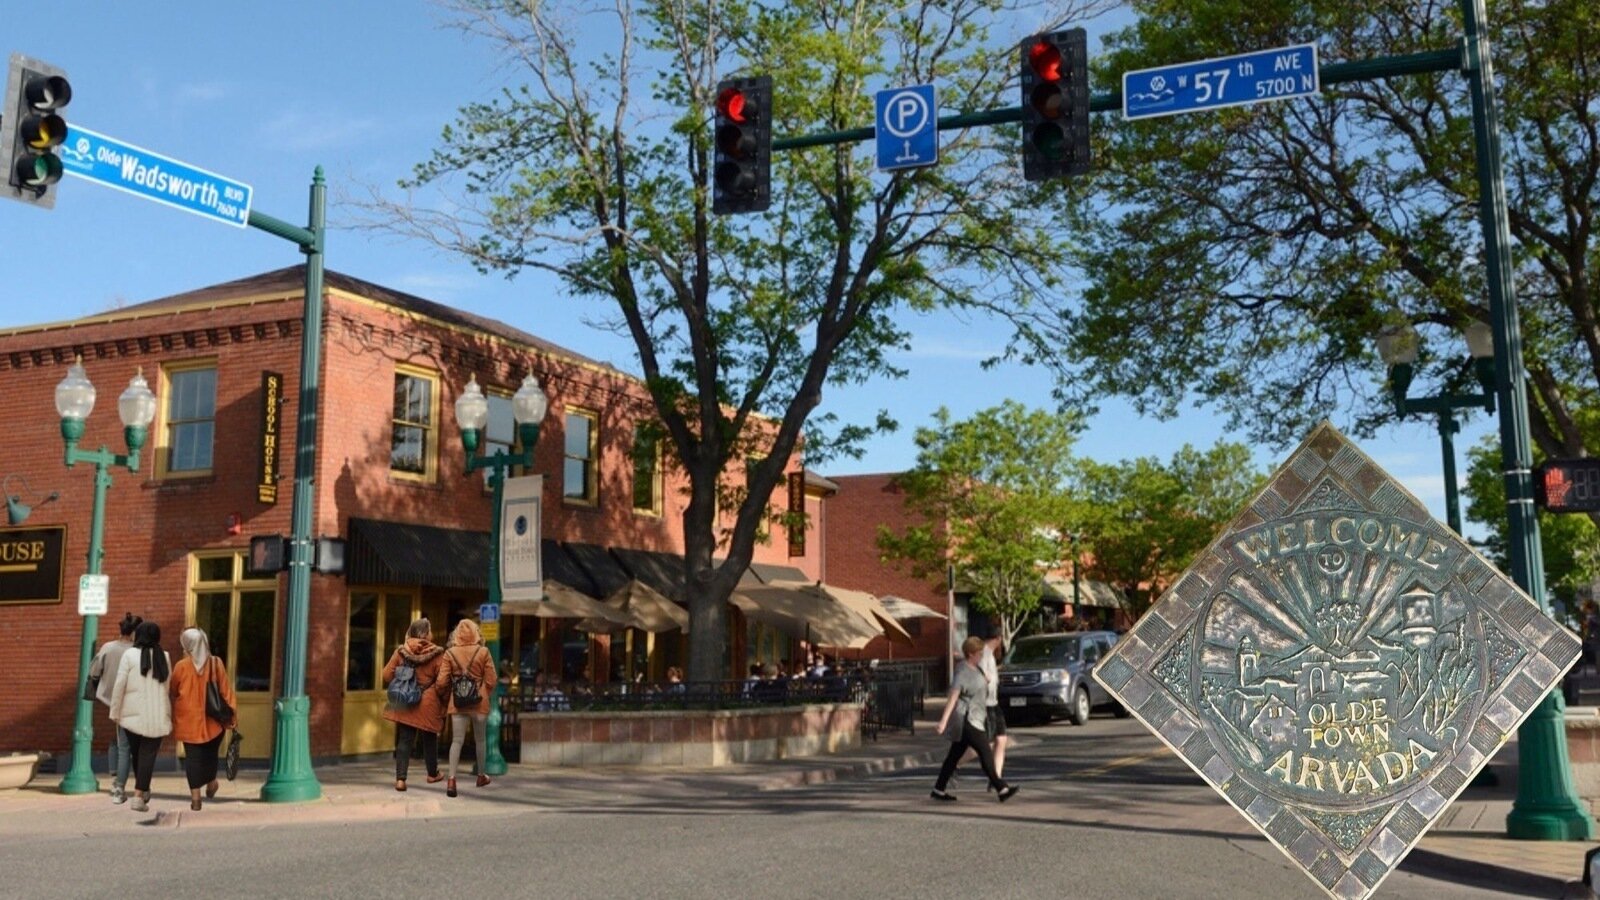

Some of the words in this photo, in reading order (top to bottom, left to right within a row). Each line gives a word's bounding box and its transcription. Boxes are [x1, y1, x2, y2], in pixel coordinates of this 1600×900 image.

[1177, 75, 1188, 88] W
[1194, 68, 1231, 102] 57
[1238, 62, 1254, 77] th
[1274, 53, 1301, 72] AVE
[1256, 77, 1295, 97] 5700
[1302, 75, 1313, 90] N
[898, 99, 918, 129] P
[97, 146, 121, 167] Olde
[121, 153, 219, 208] Wadsworth
[224, 186, 245, 202] BLVD
[0, 541, 45, 562] USE
[1235, 516, 1448, 570] WELCOME
[1321, 553, 1342, 566] TO
[1308, 698, 1389, 725] OLDE
[1302, 722, 1389, 749] TOWN
[1264, 739, 1438, 794] ARVADA
